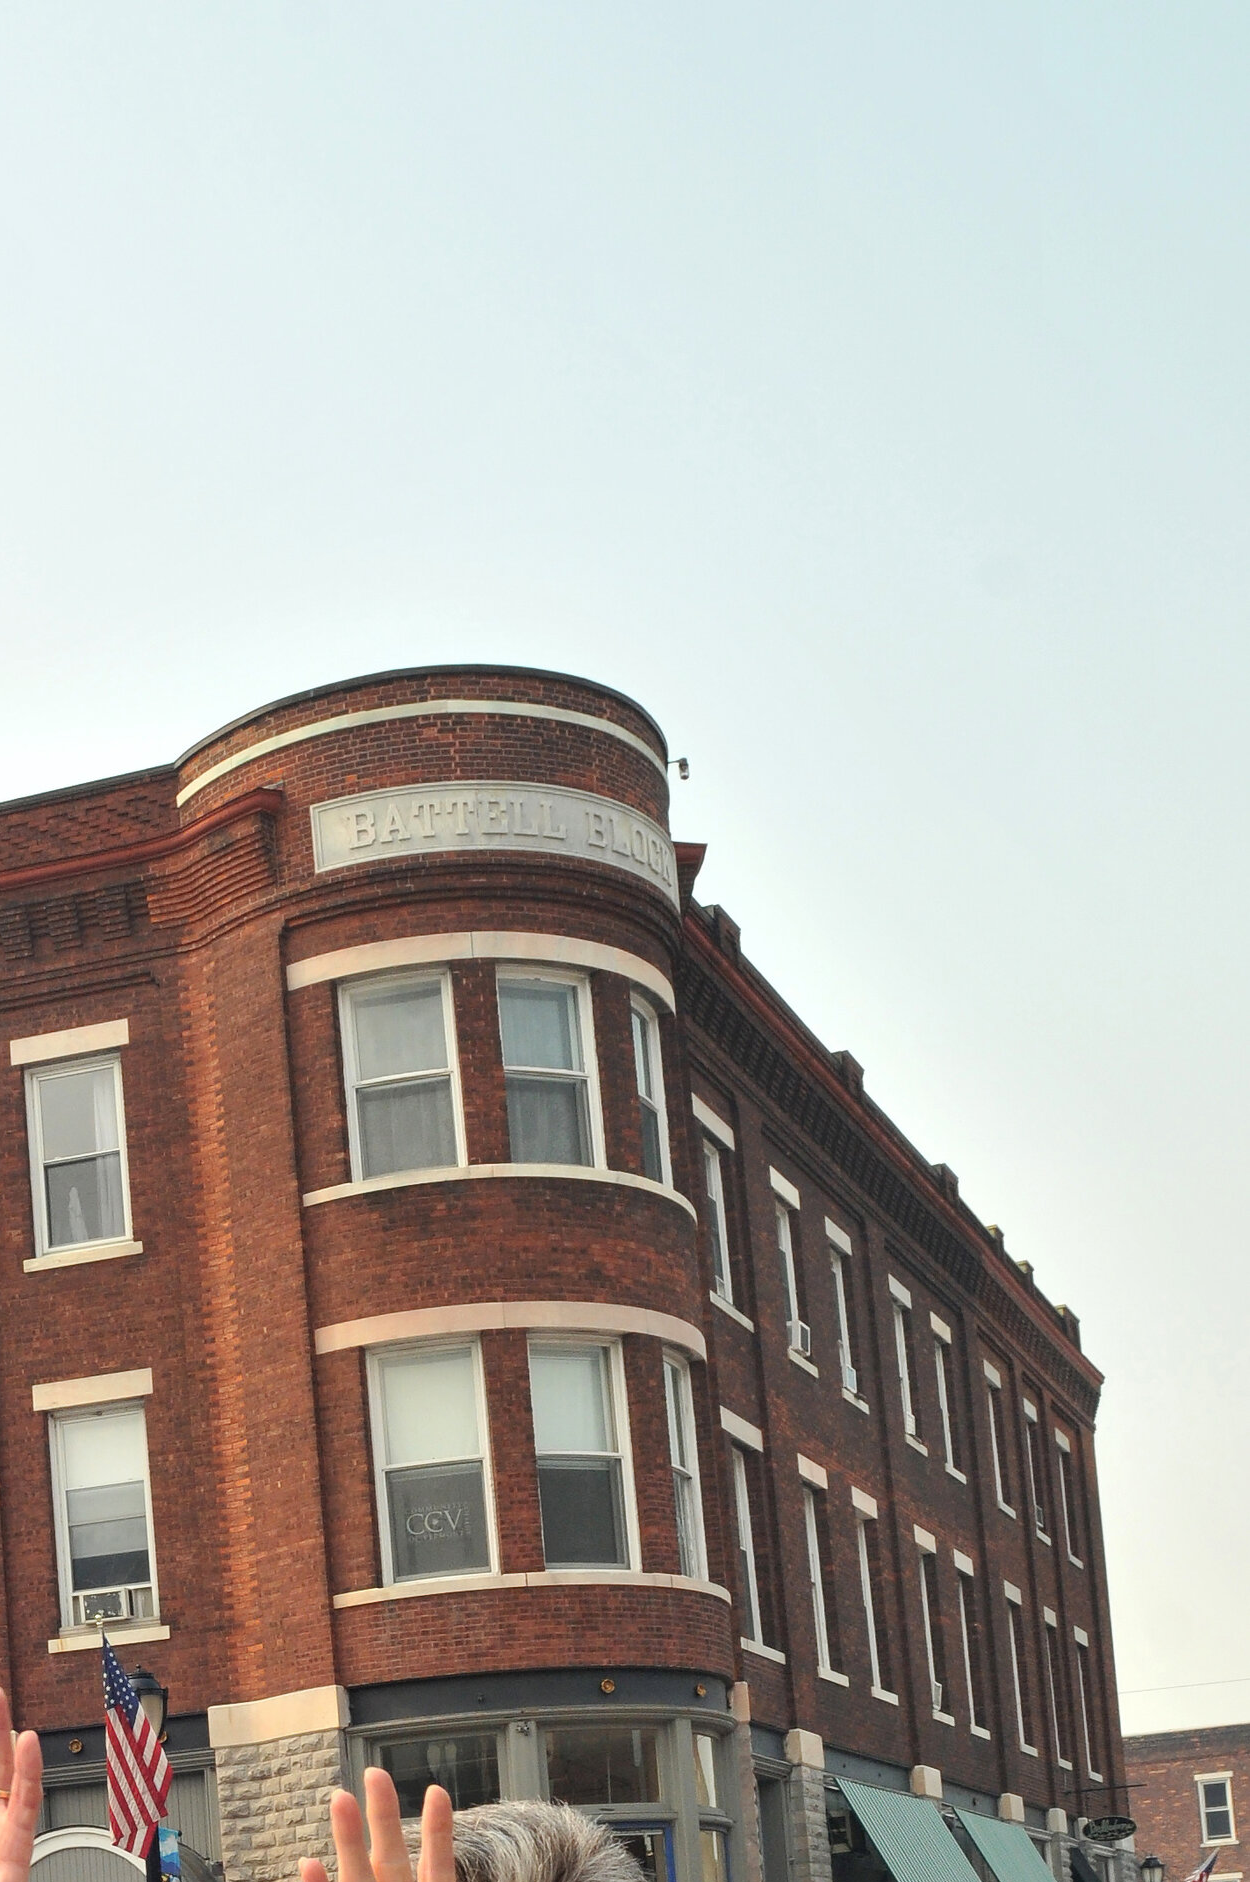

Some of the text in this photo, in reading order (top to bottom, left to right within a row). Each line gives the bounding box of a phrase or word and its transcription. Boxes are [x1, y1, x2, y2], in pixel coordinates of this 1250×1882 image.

[346, 799, 673, 888] BATTELL BLOCK
[406, 1508, 463, 1536] CCV
